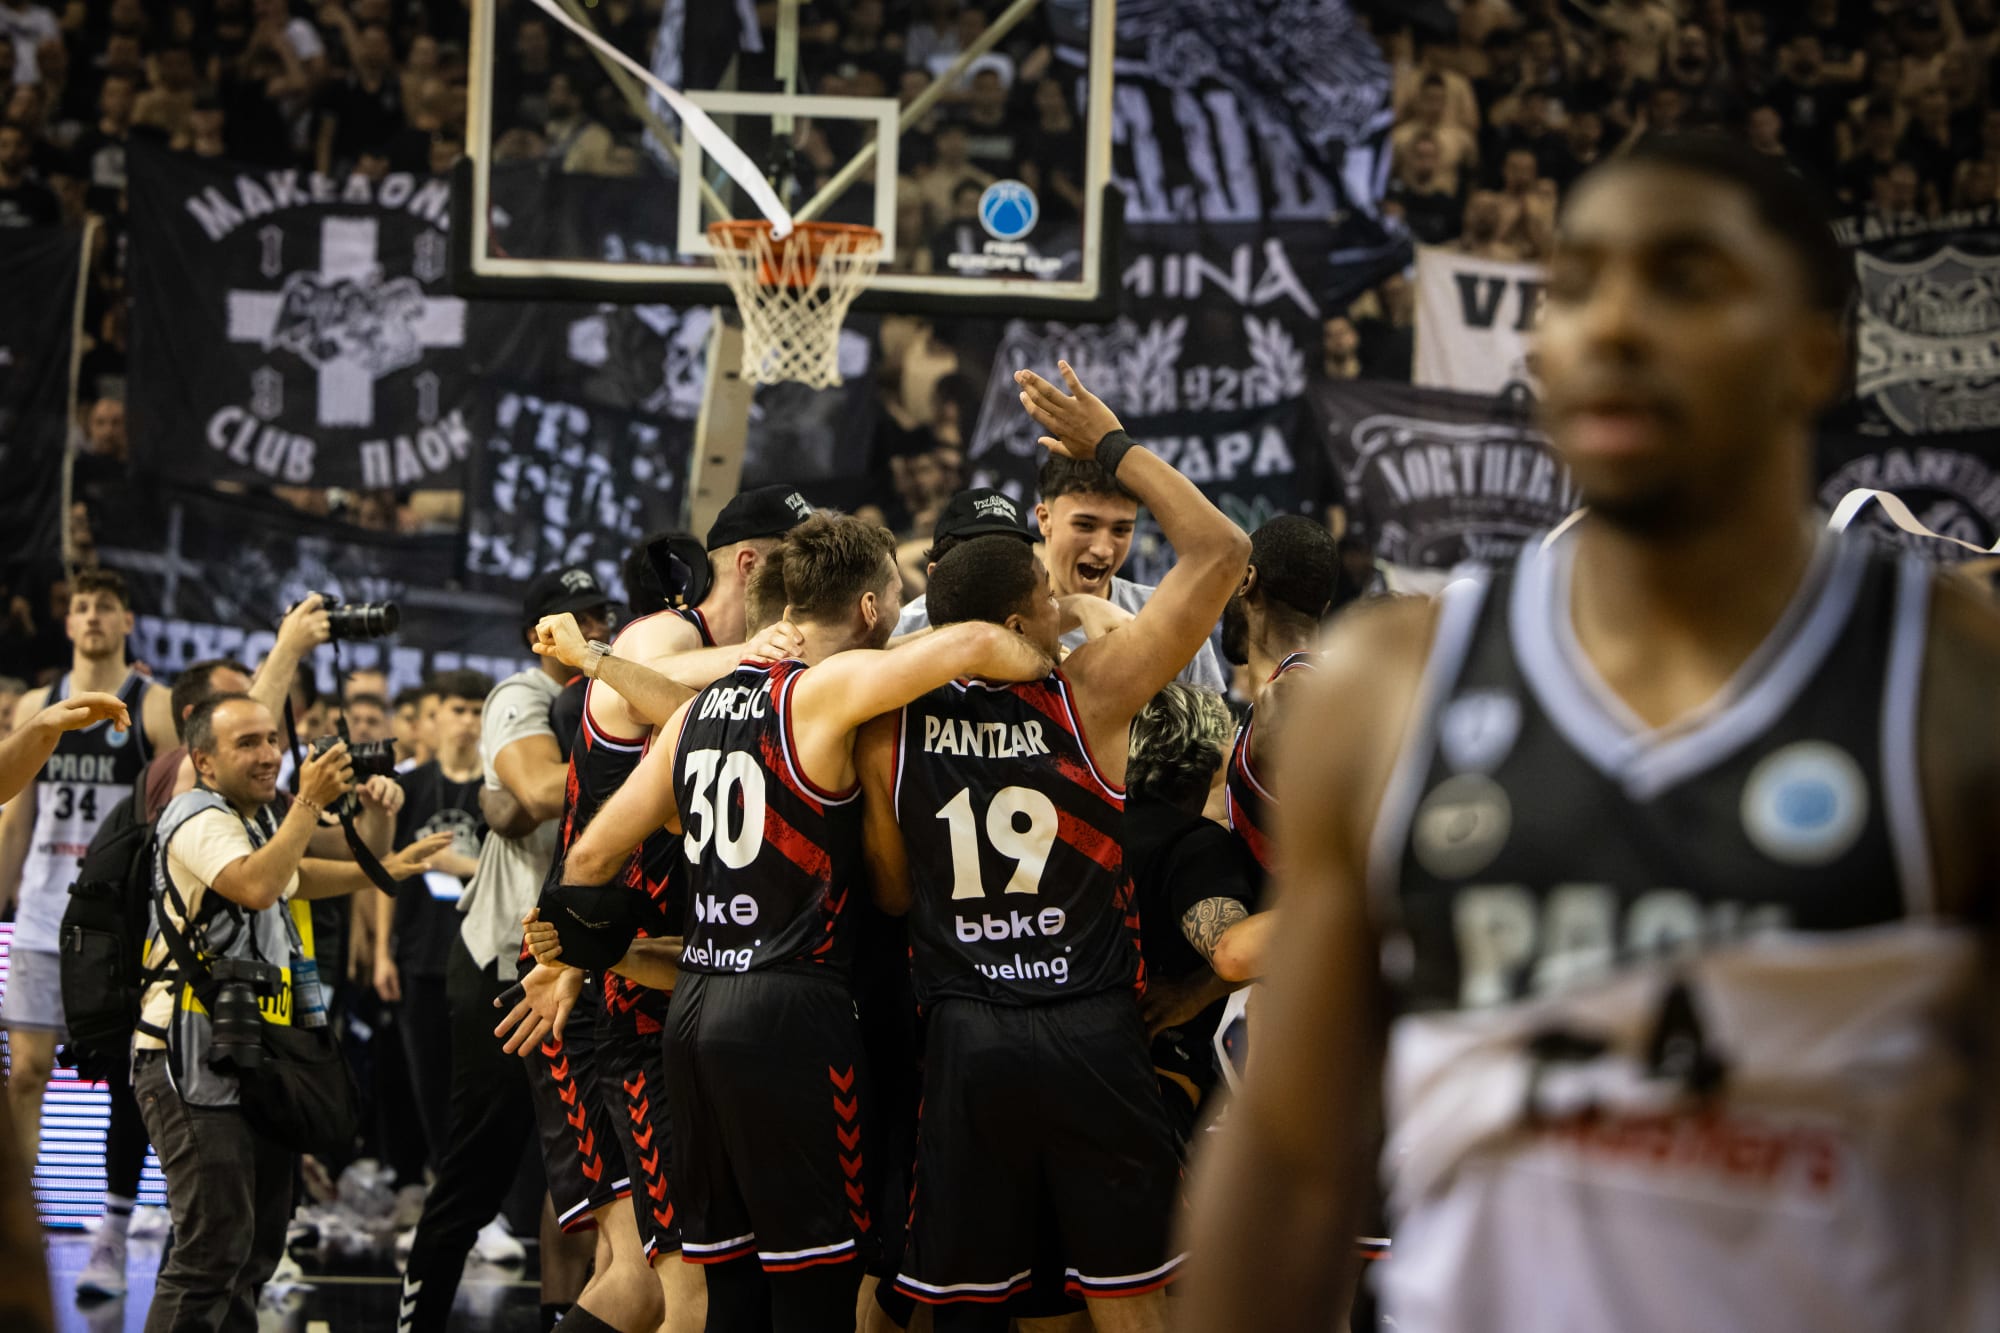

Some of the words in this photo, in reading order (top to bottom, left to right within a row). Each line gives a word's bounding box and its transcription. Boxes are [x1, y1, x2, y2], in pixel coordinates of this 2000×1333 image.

[185, 168, 451, 242] ΜΑΚΕΔΟΝ
[206, 404, 318, 484] CLUB
[47, 753, 115, 782] PAOK
[924, 715, 1051, 759] PANTZAR
[55, 786, 97, 821] 34
[684, 748, 766, 870] 30
[936, 786, 1058, 900] 19
[974, 946, 1072, 984] ueling
[1451, 881, 1792, 1006] PAO
